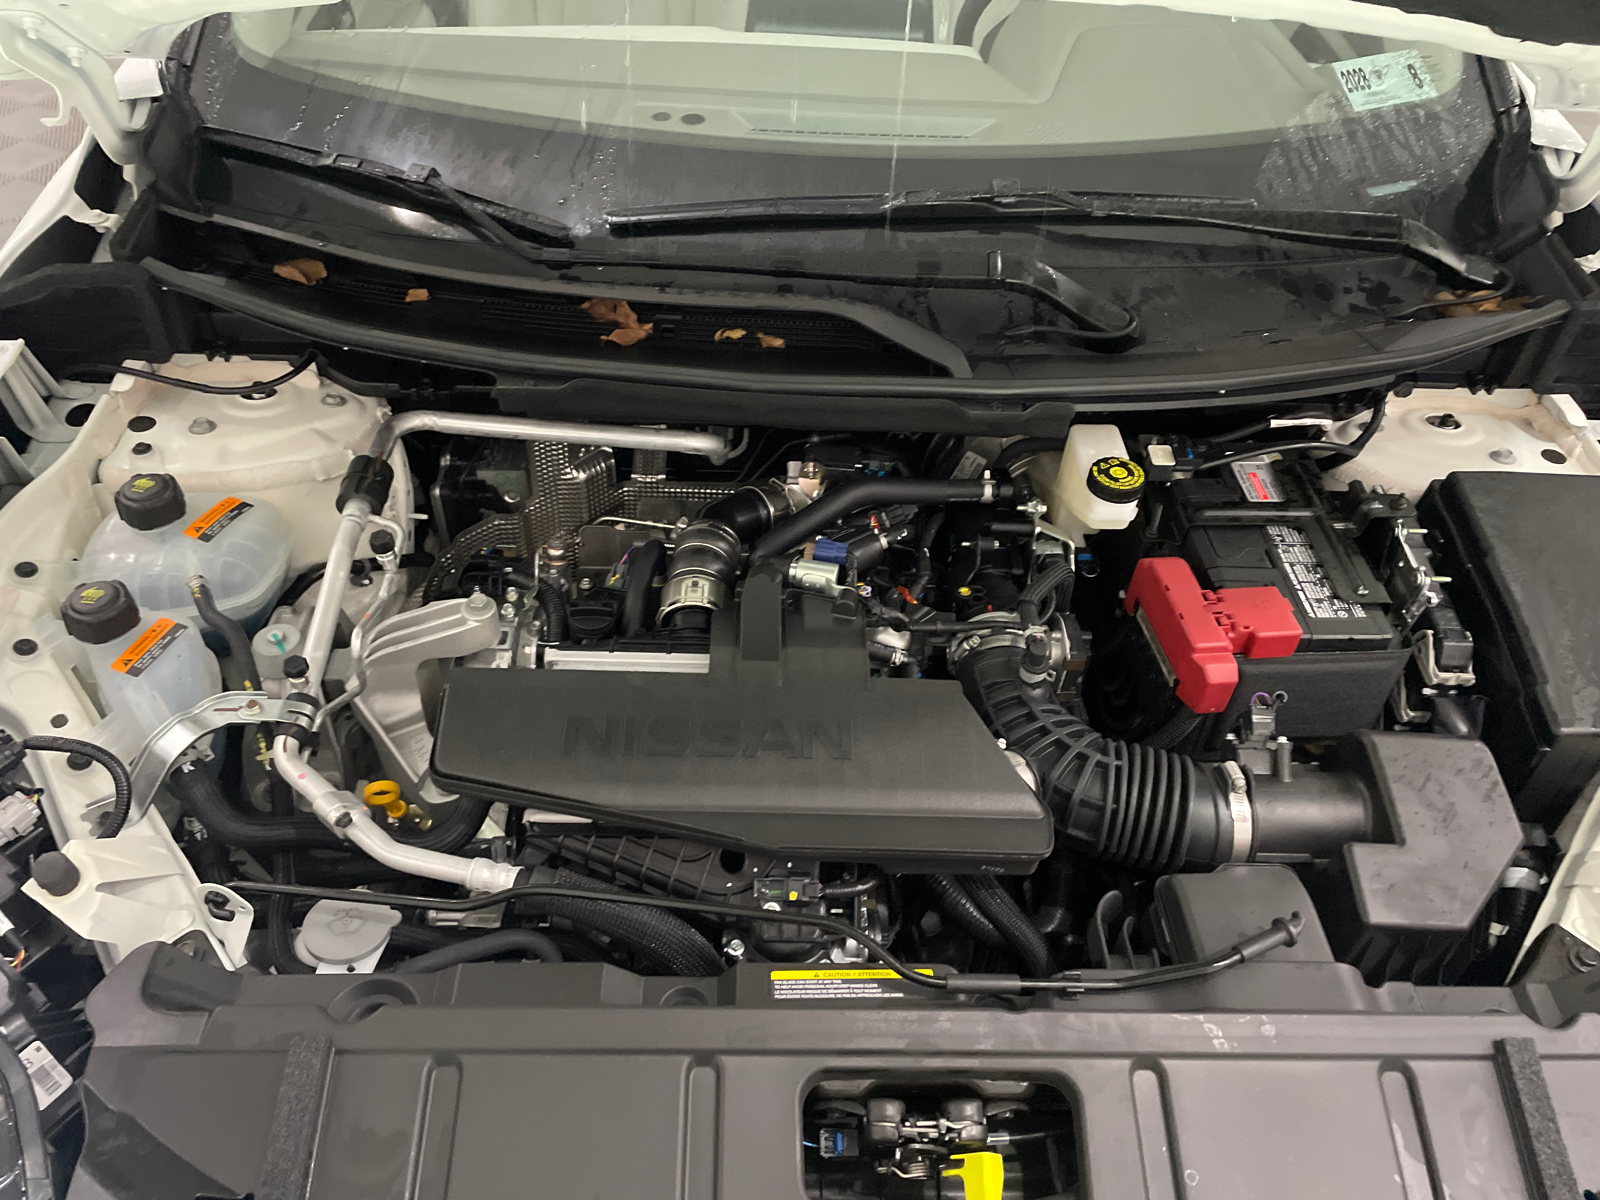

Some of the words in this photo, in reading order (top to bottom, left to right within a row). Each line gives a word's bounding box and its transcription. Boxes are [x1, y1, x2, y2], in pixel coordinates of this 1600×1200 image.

[1340, 67, 1372, 93] 2028
[1407, 63, 1424, 89] 8
[562, 714, 853, 760] NISSAN
